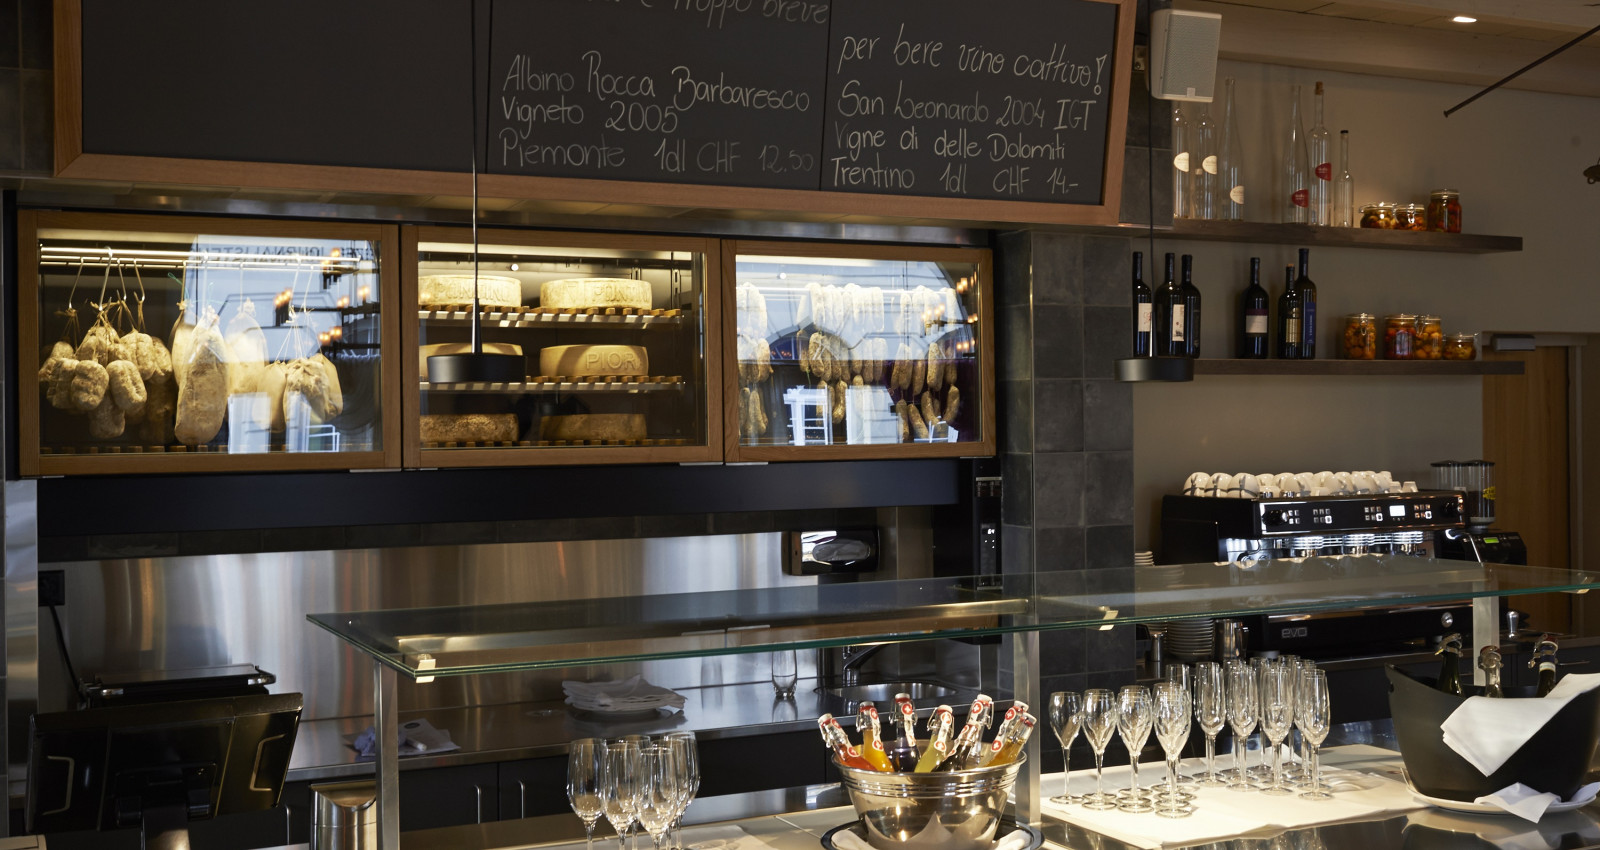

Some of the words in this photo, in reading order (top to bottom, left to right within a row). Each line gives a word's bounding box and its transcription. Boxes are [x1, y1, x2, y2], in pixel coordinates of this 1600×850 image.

[762, 0, 829, 24] breve
[502, 54, 575, 92] Albino
[582, 50, 656, 101] Rocca
[671, 66, 810, 112] Barbaresco
[837, 36, 880, 75] per
[893, 23, 943, 68] bere
[958, 44, 1006, 74] vino
[1013, 42, 1107, 96] cattivo!
[501, 95, 584, 140] Vigneto
[604, 100, 679, 134] 2005
[837, 80, 884, 117] San
[893, 80, 989, 123] Leonardo
[995, 96, 1046, 128] 2004
[1053, 99, 1097, 131] IGT
[499, 127, 626, 169] Piemonte
[653, 138, 686, 173] 1dl
[696, 141, 741, 173] CHF
[758, 144, 814, 174] 12.50
[834, 121, 886, 162] Vigne
[899, 125, 919, 150] di
[934, 128, 982, 158] delle
[986, 132, 1065, 162] Dolomiti
[831, 152, 915, 190] Trentino
[939, 161, 968, 194] 1dl
[992, 165, 1031, 195] CHF
